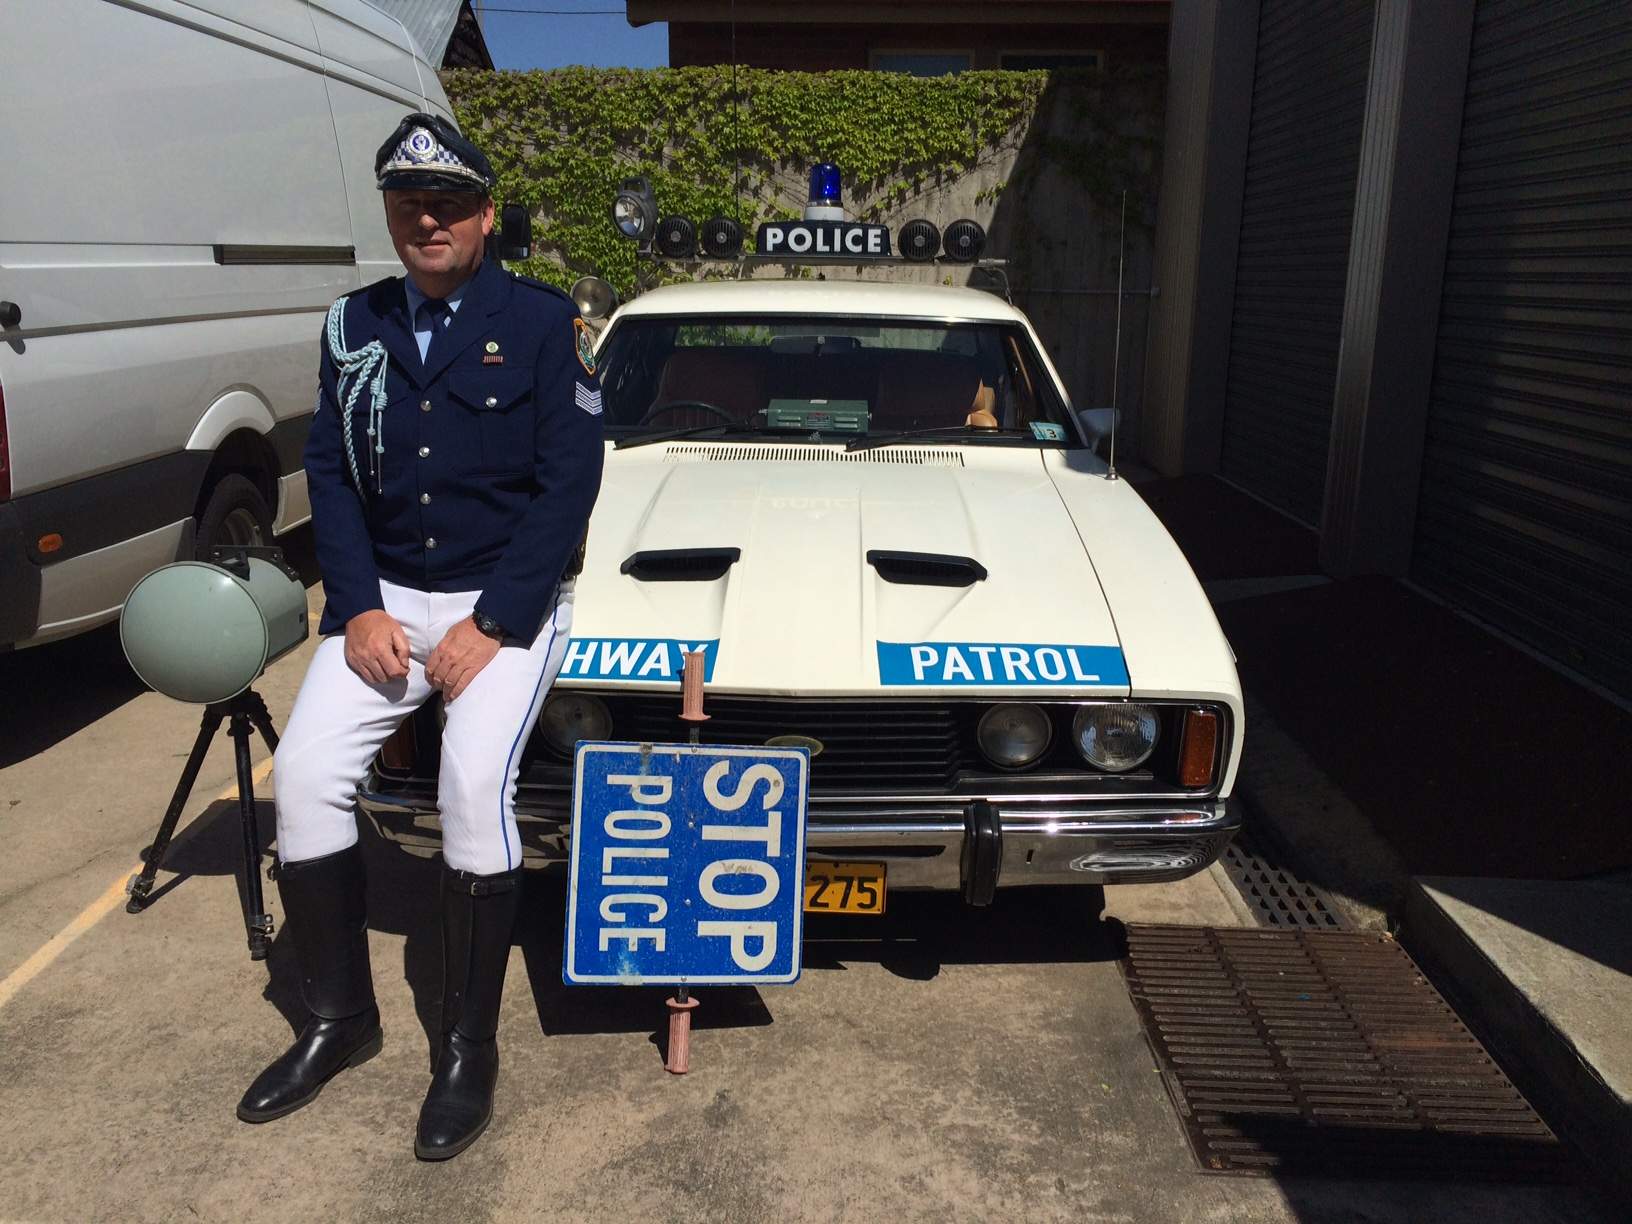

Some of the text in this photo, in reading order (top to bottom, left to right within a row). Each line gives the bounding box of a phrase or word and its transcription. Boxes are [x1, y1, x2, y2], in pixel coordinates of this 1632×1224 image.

[766, 227, 881, 253] POLICE
[910, 646, 1100, 682] PATROL
[598, 774, 673, 952] POLICE
[697, 759, 785, 972] STOP
[809, 875, 877, 909] 275
